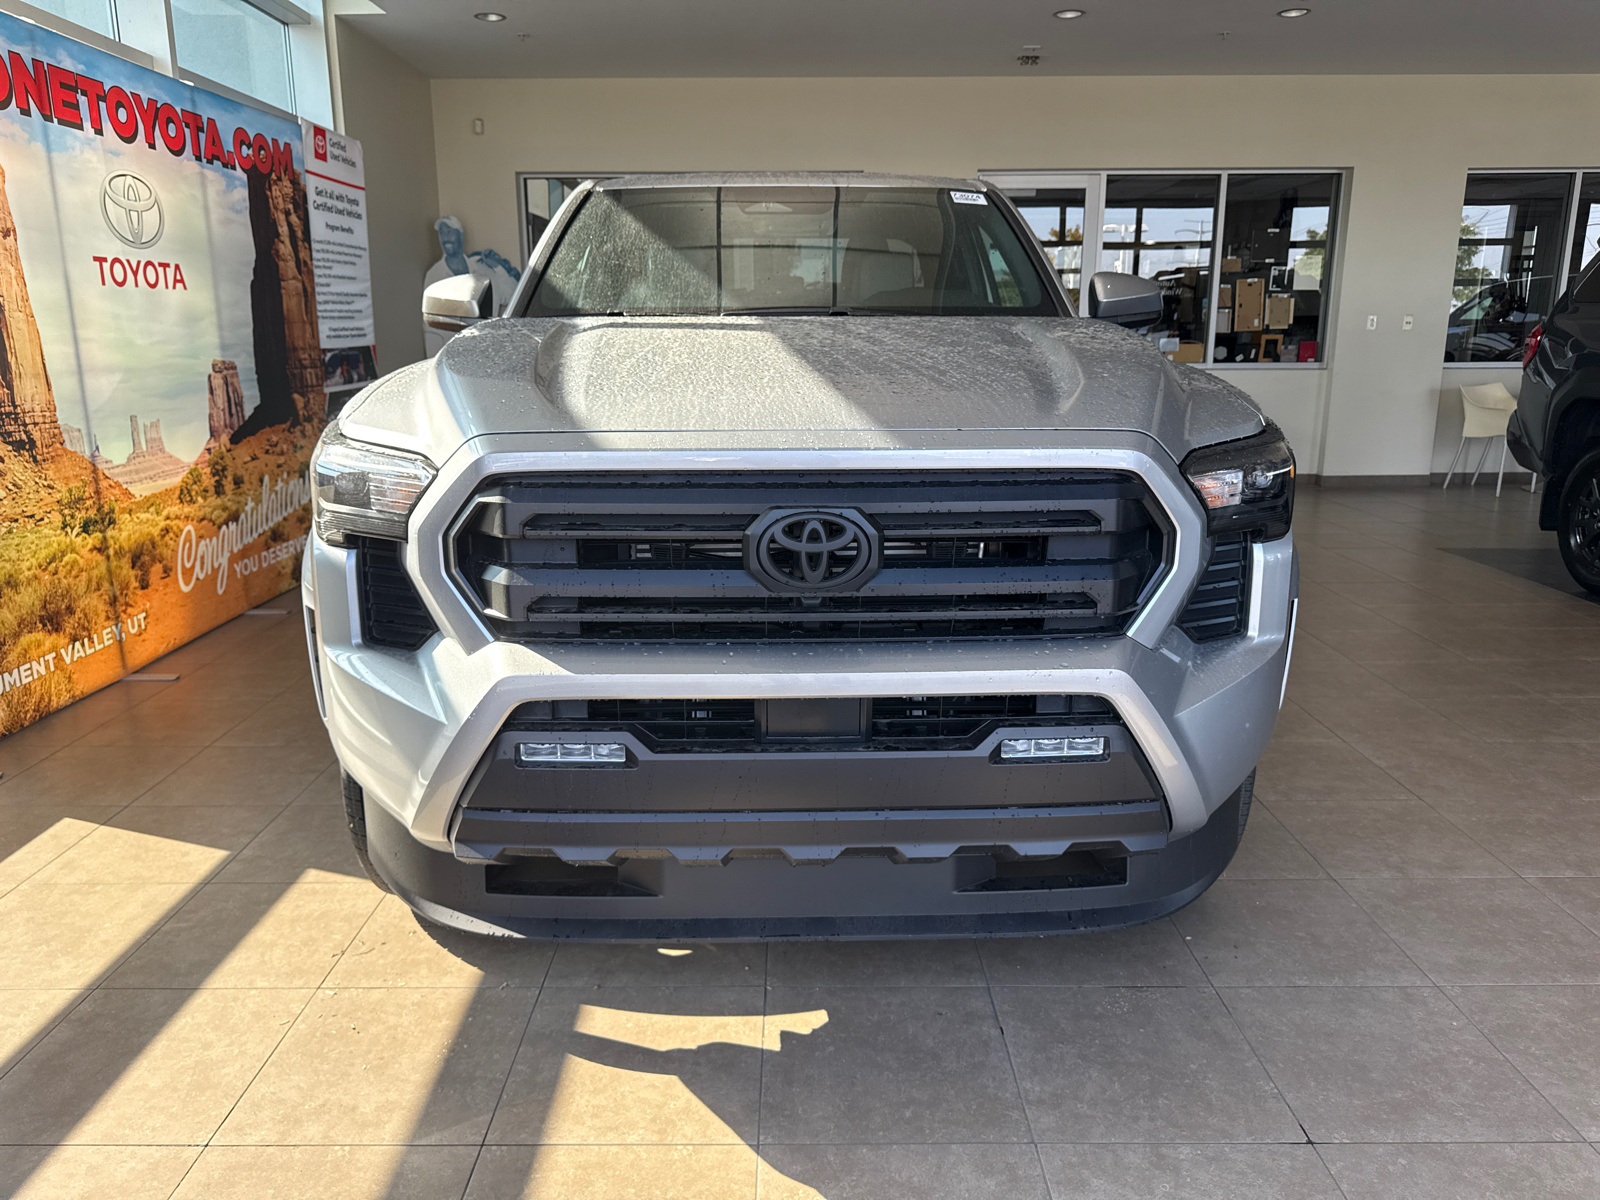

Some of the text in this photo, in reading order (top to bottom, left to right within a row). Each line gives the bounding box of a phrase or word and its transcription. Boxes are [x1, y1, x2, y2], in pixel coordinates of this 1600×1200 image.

[0, 49, 295, 181] NETOYOTA.COM
[329, 138, 347, 153] Certified
[330, 151, 357, 168] Used Vehicles
[315, 187, 324, 197] Get
[335, 192, 345, 202] with
[345, 194, 359, 207] Toyota
[313, 200, 362, 220] Certified Used Vehicles
[93, 255, 188, 291] TOYOTA
[233, 554, 259, 579] YOU
[0, 611, 147, 696] MENT VALLEY, UT
